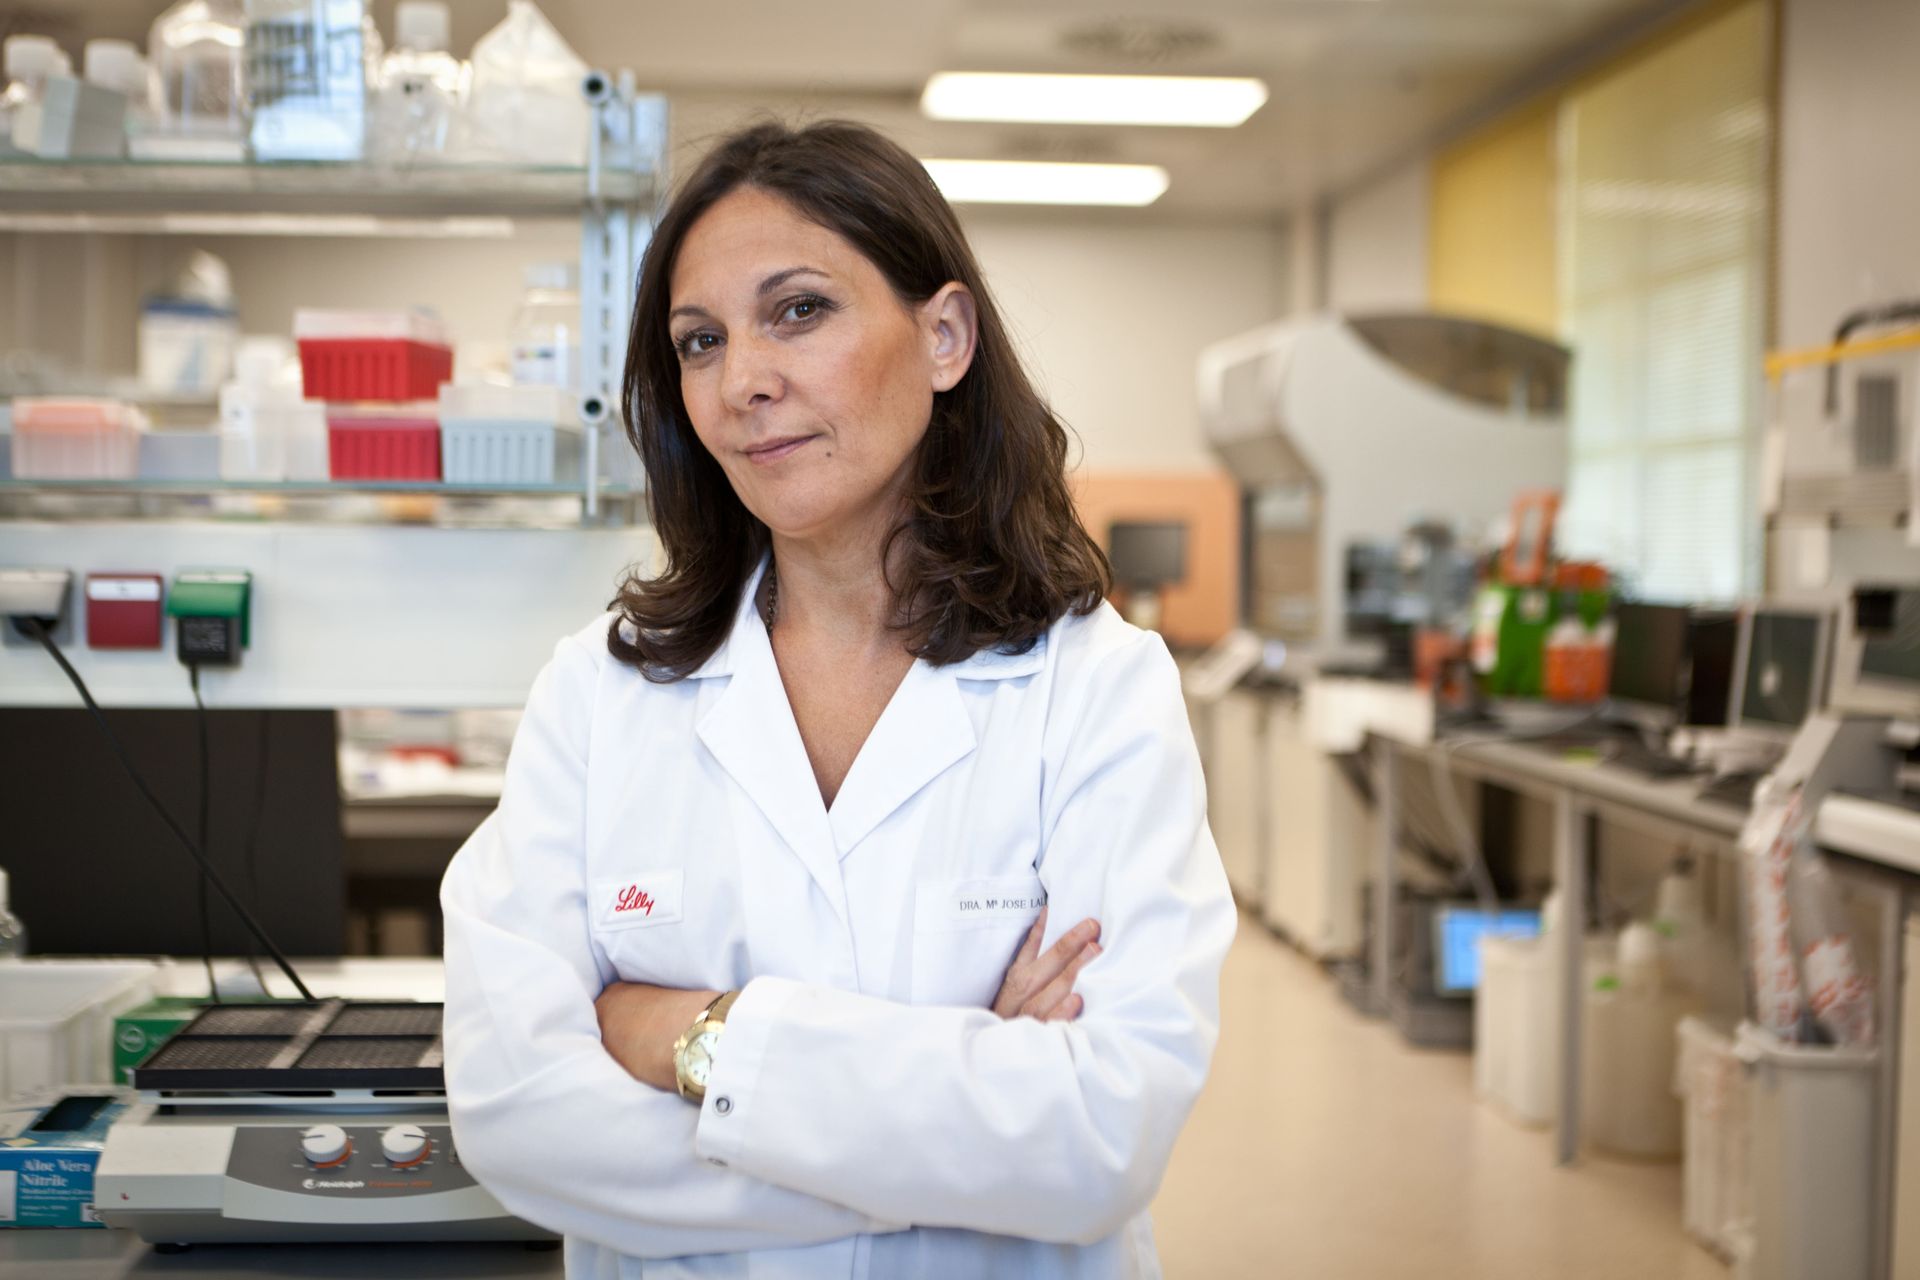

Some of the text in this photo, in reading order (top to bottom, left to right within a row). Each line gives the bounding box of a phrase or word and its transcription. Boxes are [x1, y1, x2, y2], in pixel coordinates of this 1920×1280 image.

[615, 884, 655, 916] Lilly
[960, 901, 981, 911] DRA.
[1002, 899, 1026, 909] JOSE
[23, 1159, 91, 1172] Aloe Vera
[21, 1174, 69, 1187] Nitrile
